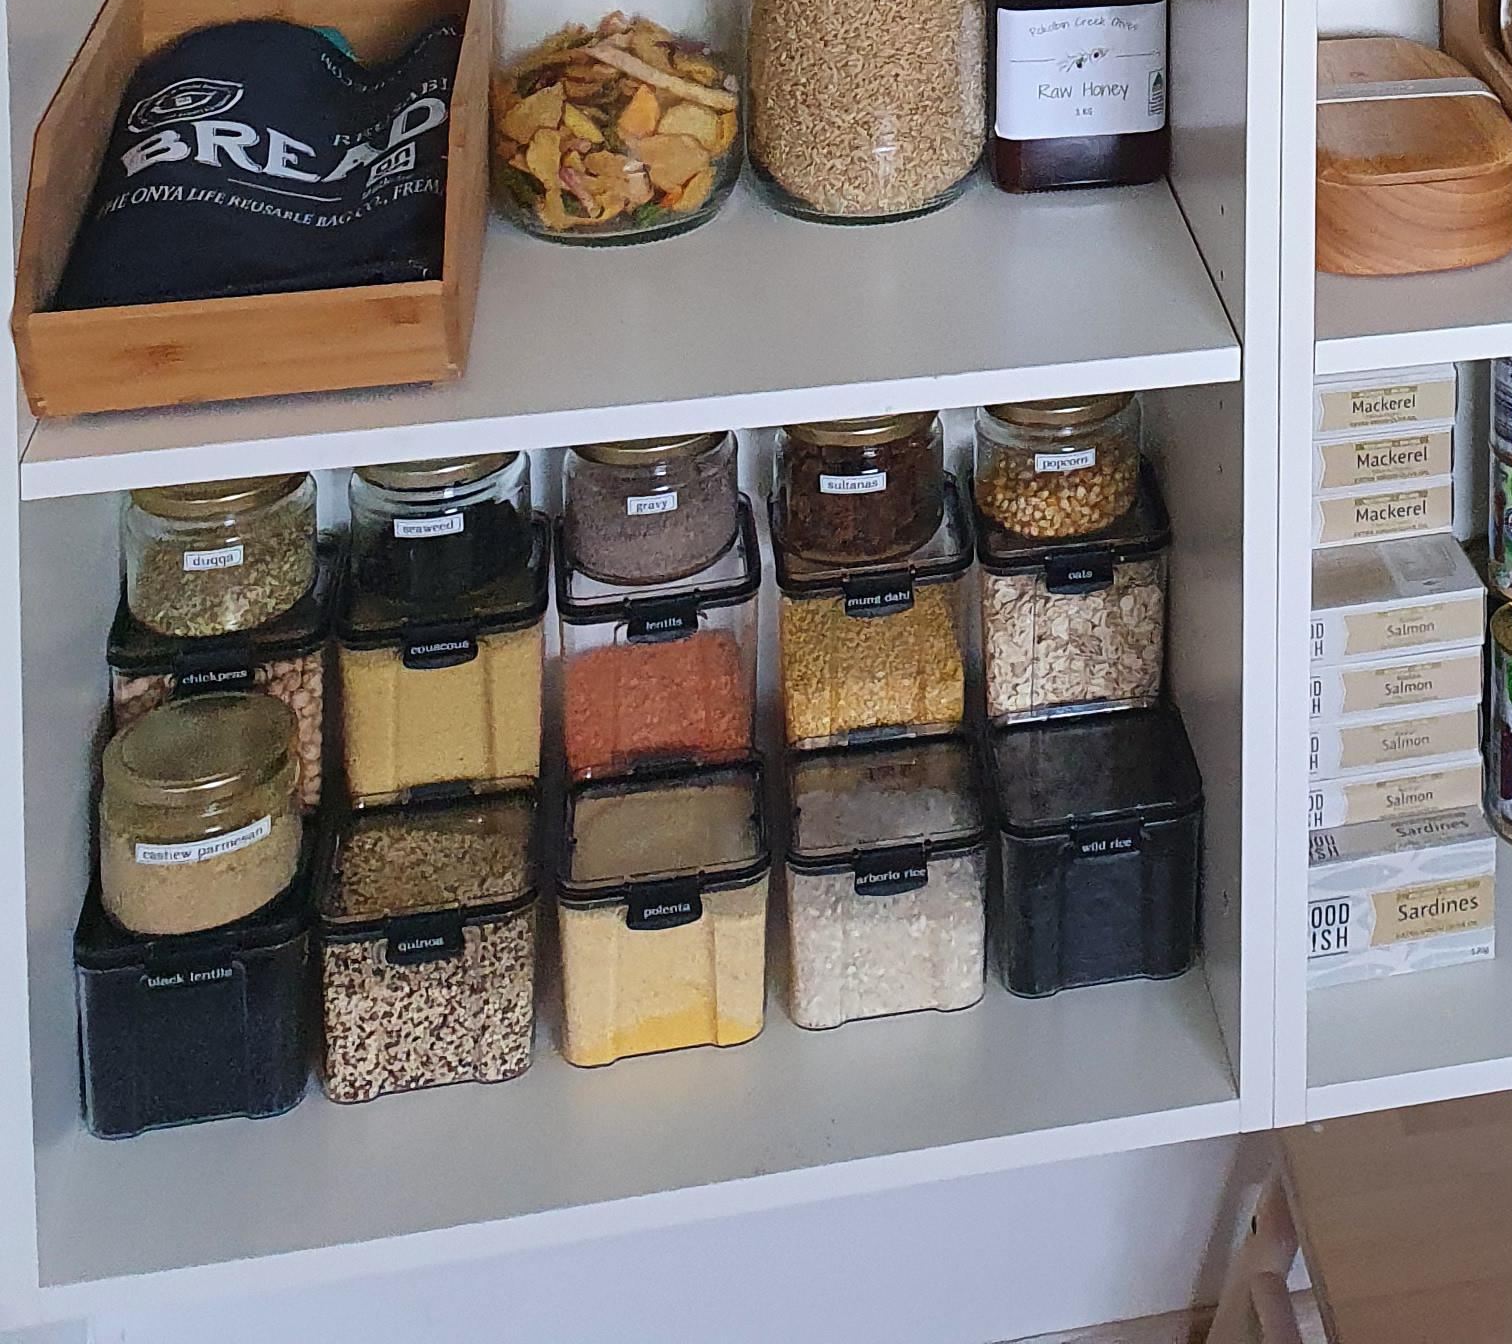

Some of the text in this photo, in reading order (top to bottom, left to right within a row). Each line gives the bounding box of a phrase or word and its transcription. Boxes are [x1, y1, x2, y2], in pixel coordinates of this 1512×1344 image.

[1038, 81, 1129, 101] Raw Honey
[121, 98, 447, 183] BREAD
[130, 185, 184, 205] ONYA
[186, 187, 225, 205] LIFE
[227, 196, 313, 226] REUSABLE
[1352, 394, 1416, 416] Mackerel
[1043, 456, 1089, 472] popcorn
[1357, 442, 1428, 469] Mackerel
[827, 477, 879, 491] sultanas
[635, 496, 669, 514] gravy
[1356, 500, 1427, 524] Mackerel
[402, 518, 455, 534] seaweed
[1067, 567, 1093, 581] oats
[847, 589, 911, 610] mung dahl
[645, 616, 683, 634] lentils
[1386, 621, 1435, 639] Salmon
[410, 638, 471, 656] couscous
[183, 668, 248, 689] chickpeas
[1384, 679, 1433, 696] Salmon
[1381, 734, 1431, 751] Salmon
[1386, 789, 1434, 808] Salmon
[1395, 817, 1470, 839] Sardines
[142, 825, 265, 863] cashew parmesan
[1081, 836, 1132, 853] wild rice
[856, 866, 927, 886] arborio rice
[643, 899, 691, 917] polenta
[1307, 902, 1350, 929] OOD
[1397, 894, 1480, 923] Sardines
[398, 935, 444, 953] quinoa
